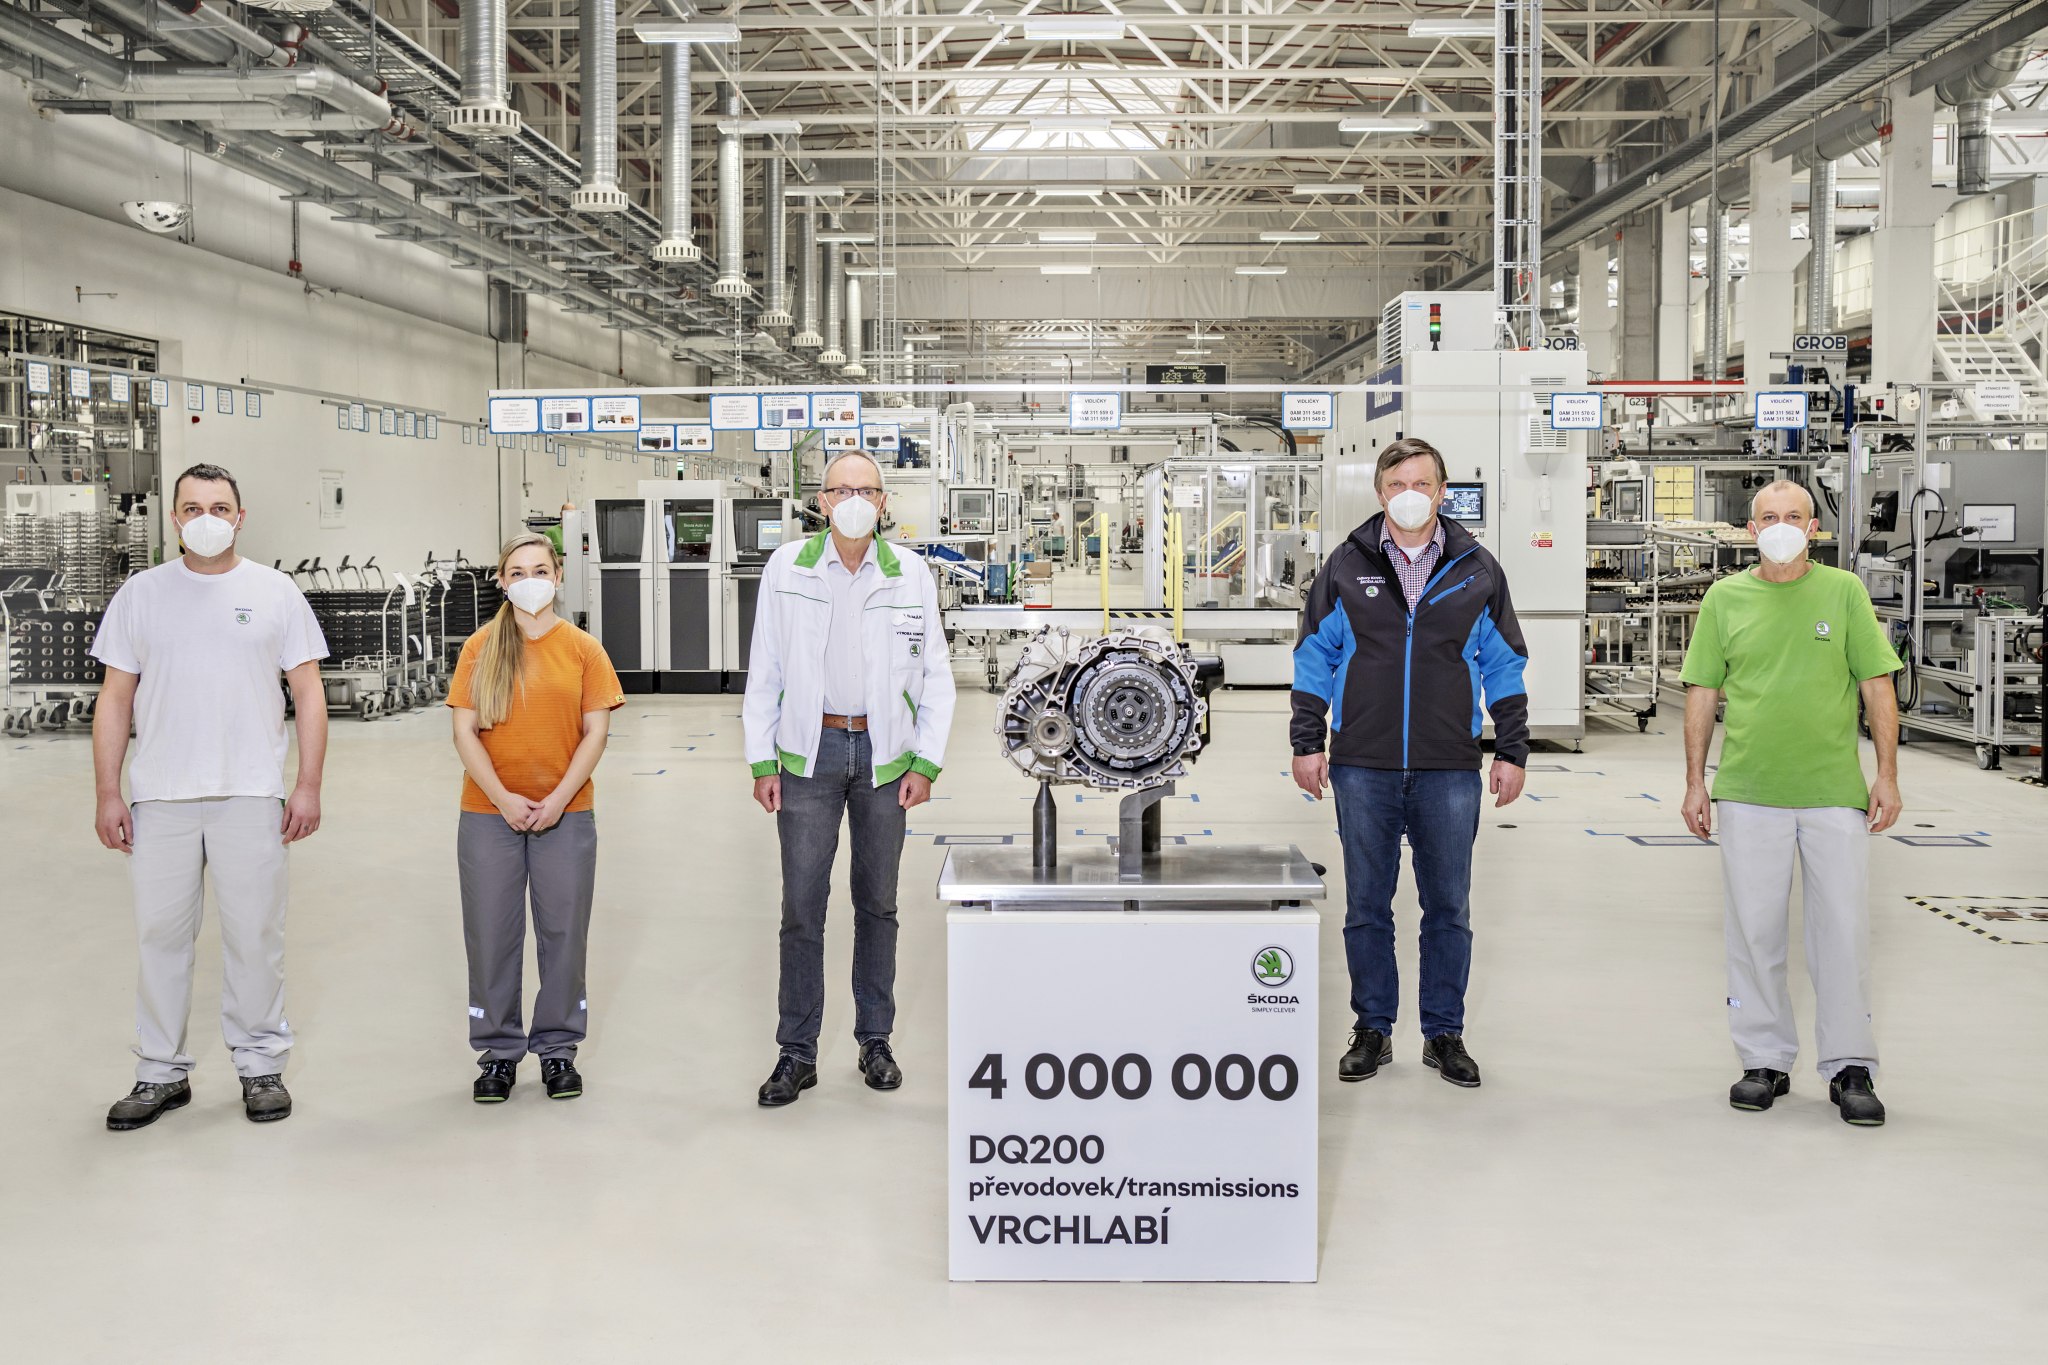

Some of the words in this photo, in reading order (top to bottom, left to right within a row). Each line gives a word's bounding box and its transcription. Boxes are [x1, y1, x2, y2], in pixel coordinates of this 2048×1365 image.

[1796, 336, 1846, 349] GROB
[1629, 398, 1646, 406] G23
[1248, 994, 1299, 1004] ŠKODA
[968, 1053, 1007, 1100] 4
[1024, 1052, 1152, 1100] 000
[1171, 1053, 1299, 1101] 000
[969, 1134, 1105, 1164] DQ200
[969, 1176, 1299, 1200] převodovek/transmissions
[968, 1206, 1171, 1244] VRCHLABÍ
